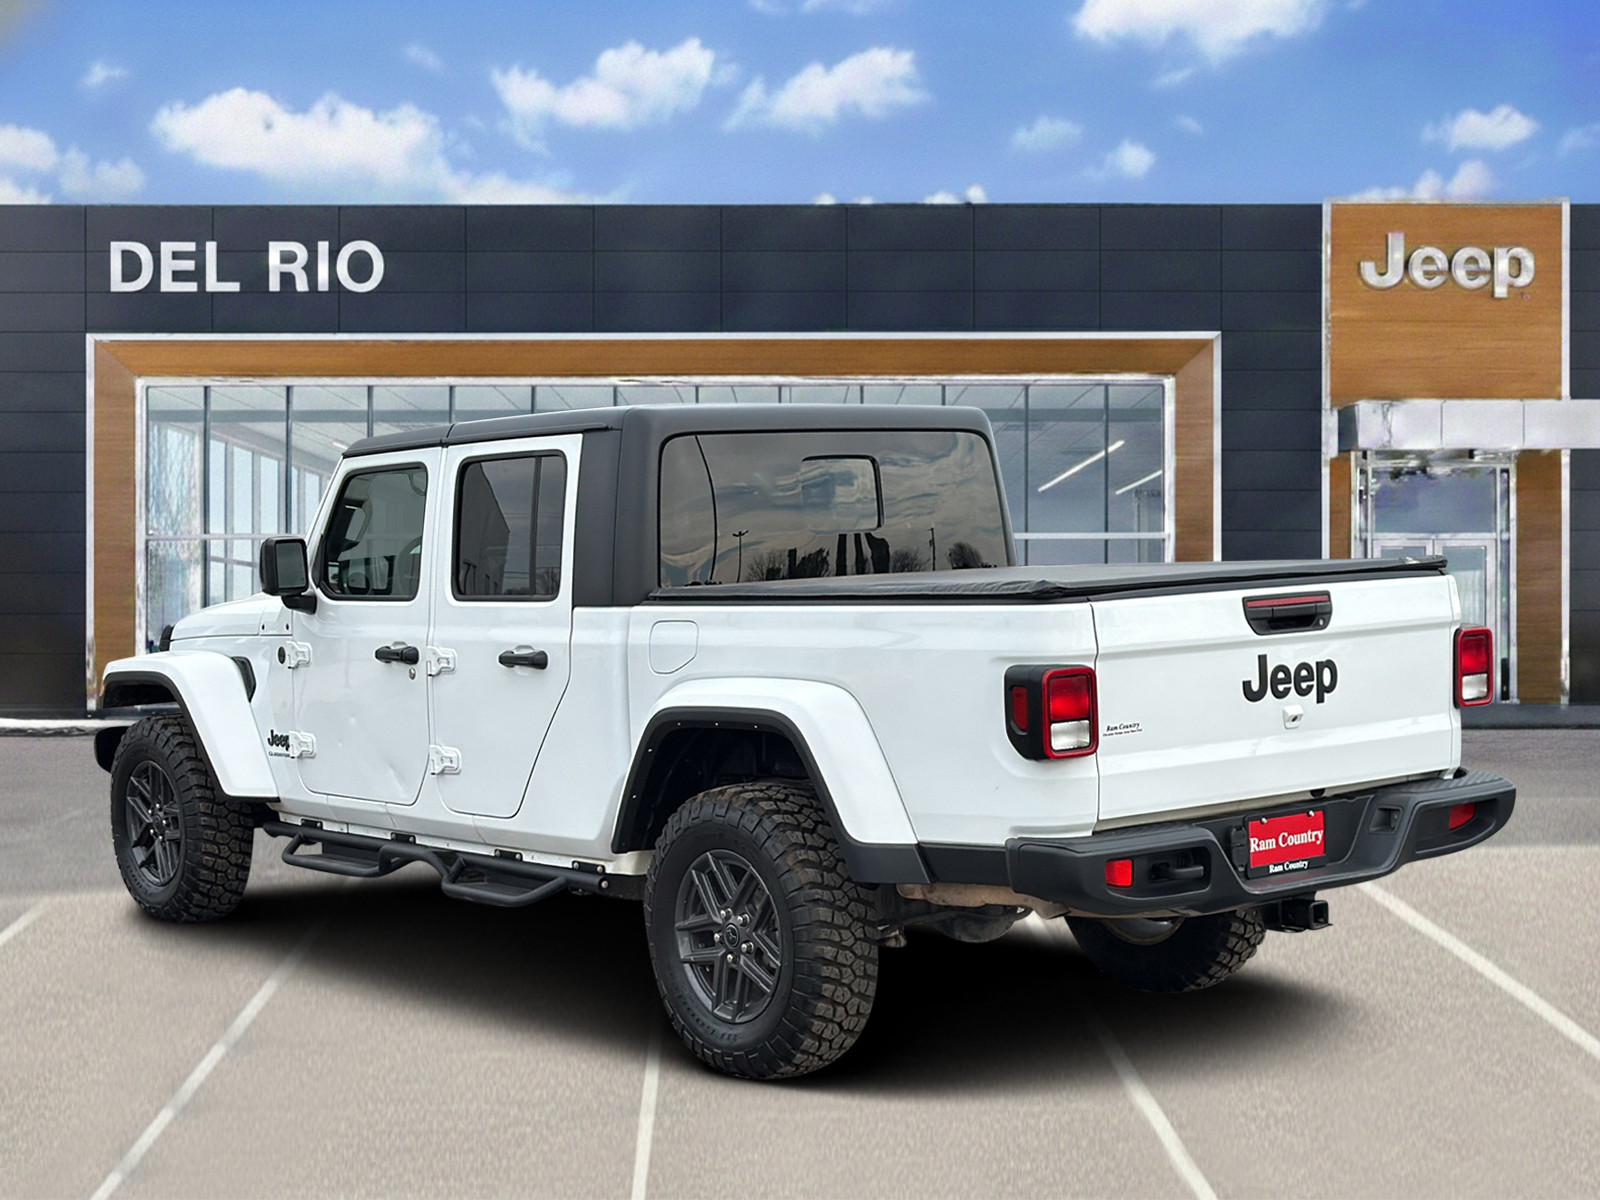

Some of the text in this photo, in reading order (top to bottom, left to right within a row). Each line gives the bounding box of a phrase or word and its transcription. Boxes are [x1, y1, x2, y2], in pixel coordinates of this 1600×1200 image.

[110, 240, 385, 293] DEL RIO
[1359, 231, 1535, 298] Jeep
[1242, 653, 1338, 704] Jeep
[267, 729, 290, 751] Jeep
[1249, 829, 1324, 853] Ram Country
[1268, 860, 1309, 874] Ram Country
